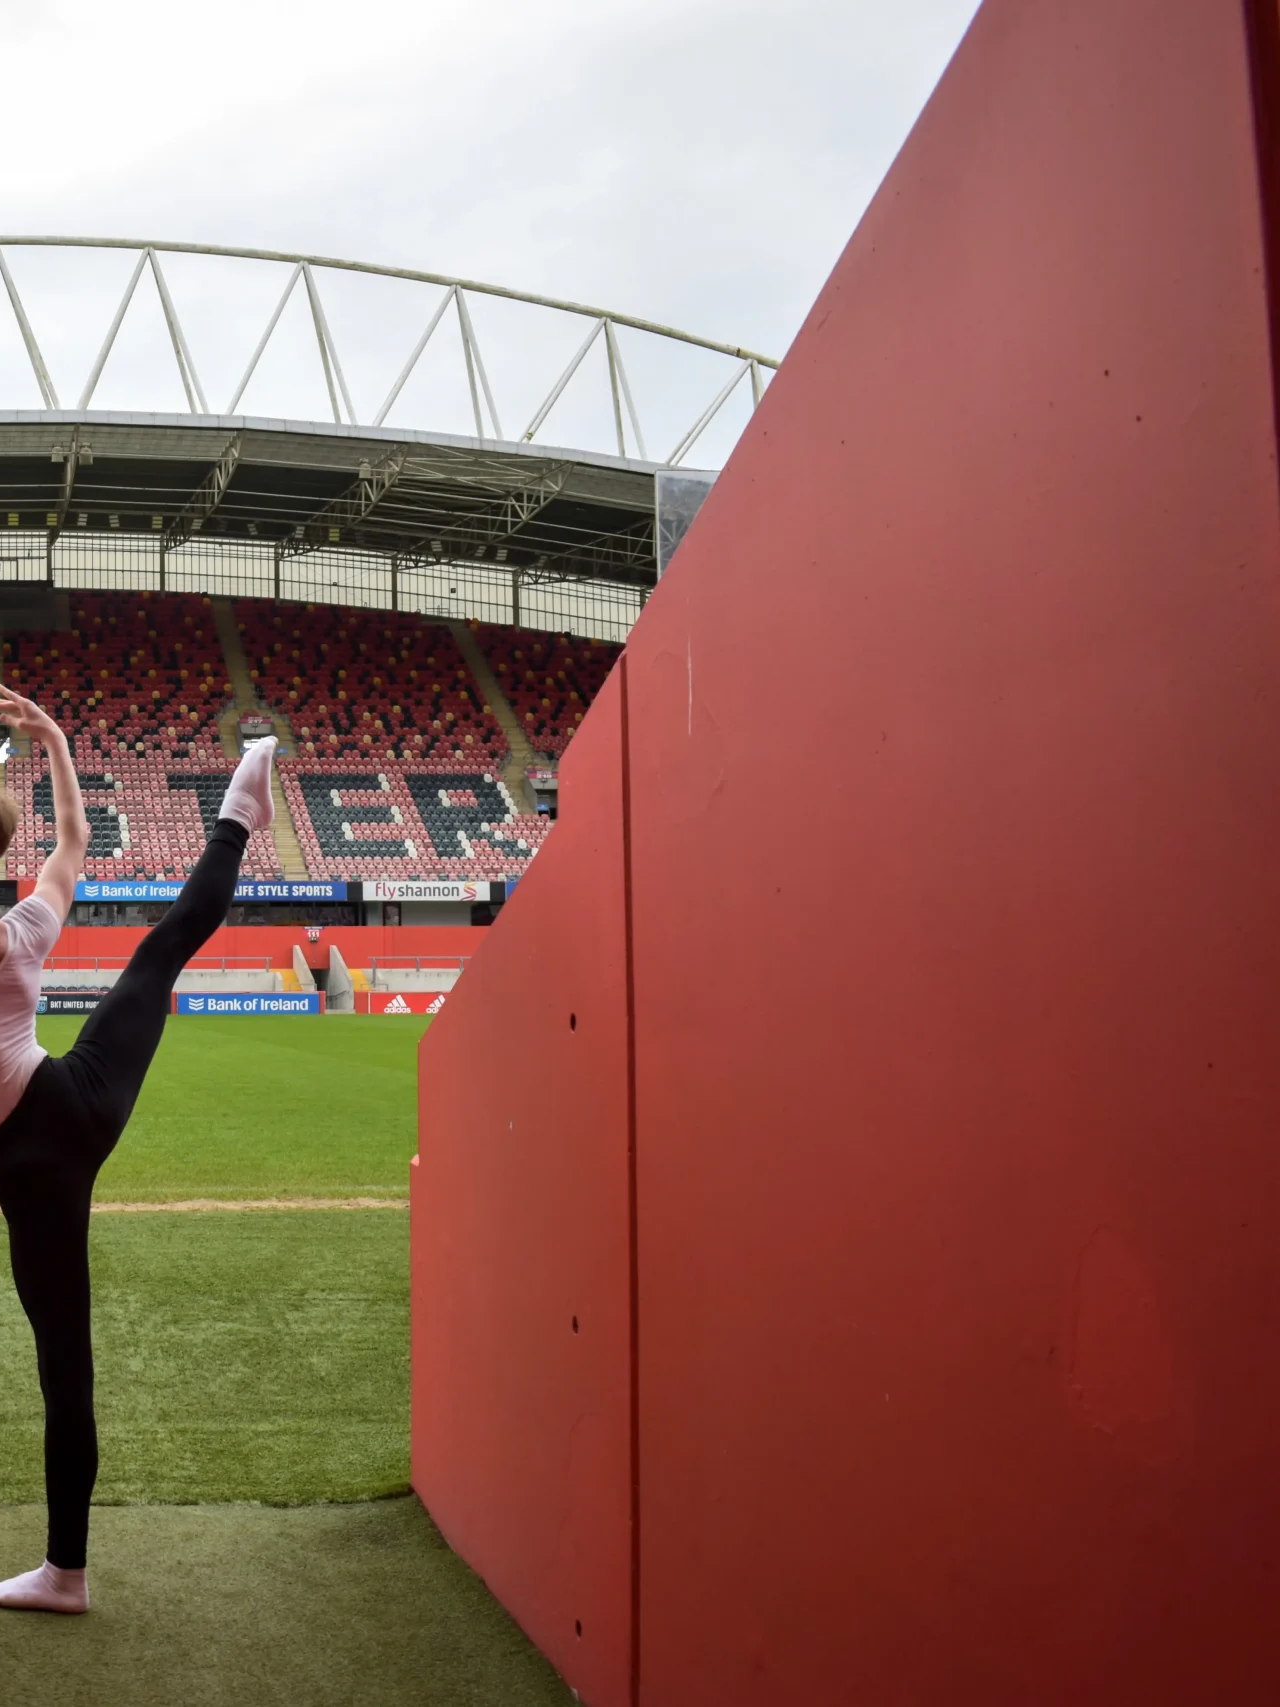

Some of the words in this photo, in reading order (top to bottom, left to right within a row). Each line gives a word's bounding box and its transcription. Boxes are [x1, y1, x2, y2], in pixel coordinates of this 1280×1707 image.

[102, 885, 133, 897] Bank
[134, 885, 148, 897] of
[257, 885, 289, 897] STYLE
[292, 885, 333, 897] SPORTS
[50, 1001, 61, 1009] BKT
[63, 1001, 84, 1009] UNITED
[207, 998, 243, 1011] Bank
[244, 998, 258, 1011] of
[260, 998, 309, 1011] Ireland
[384, 1006, 411, 1014] adidas
